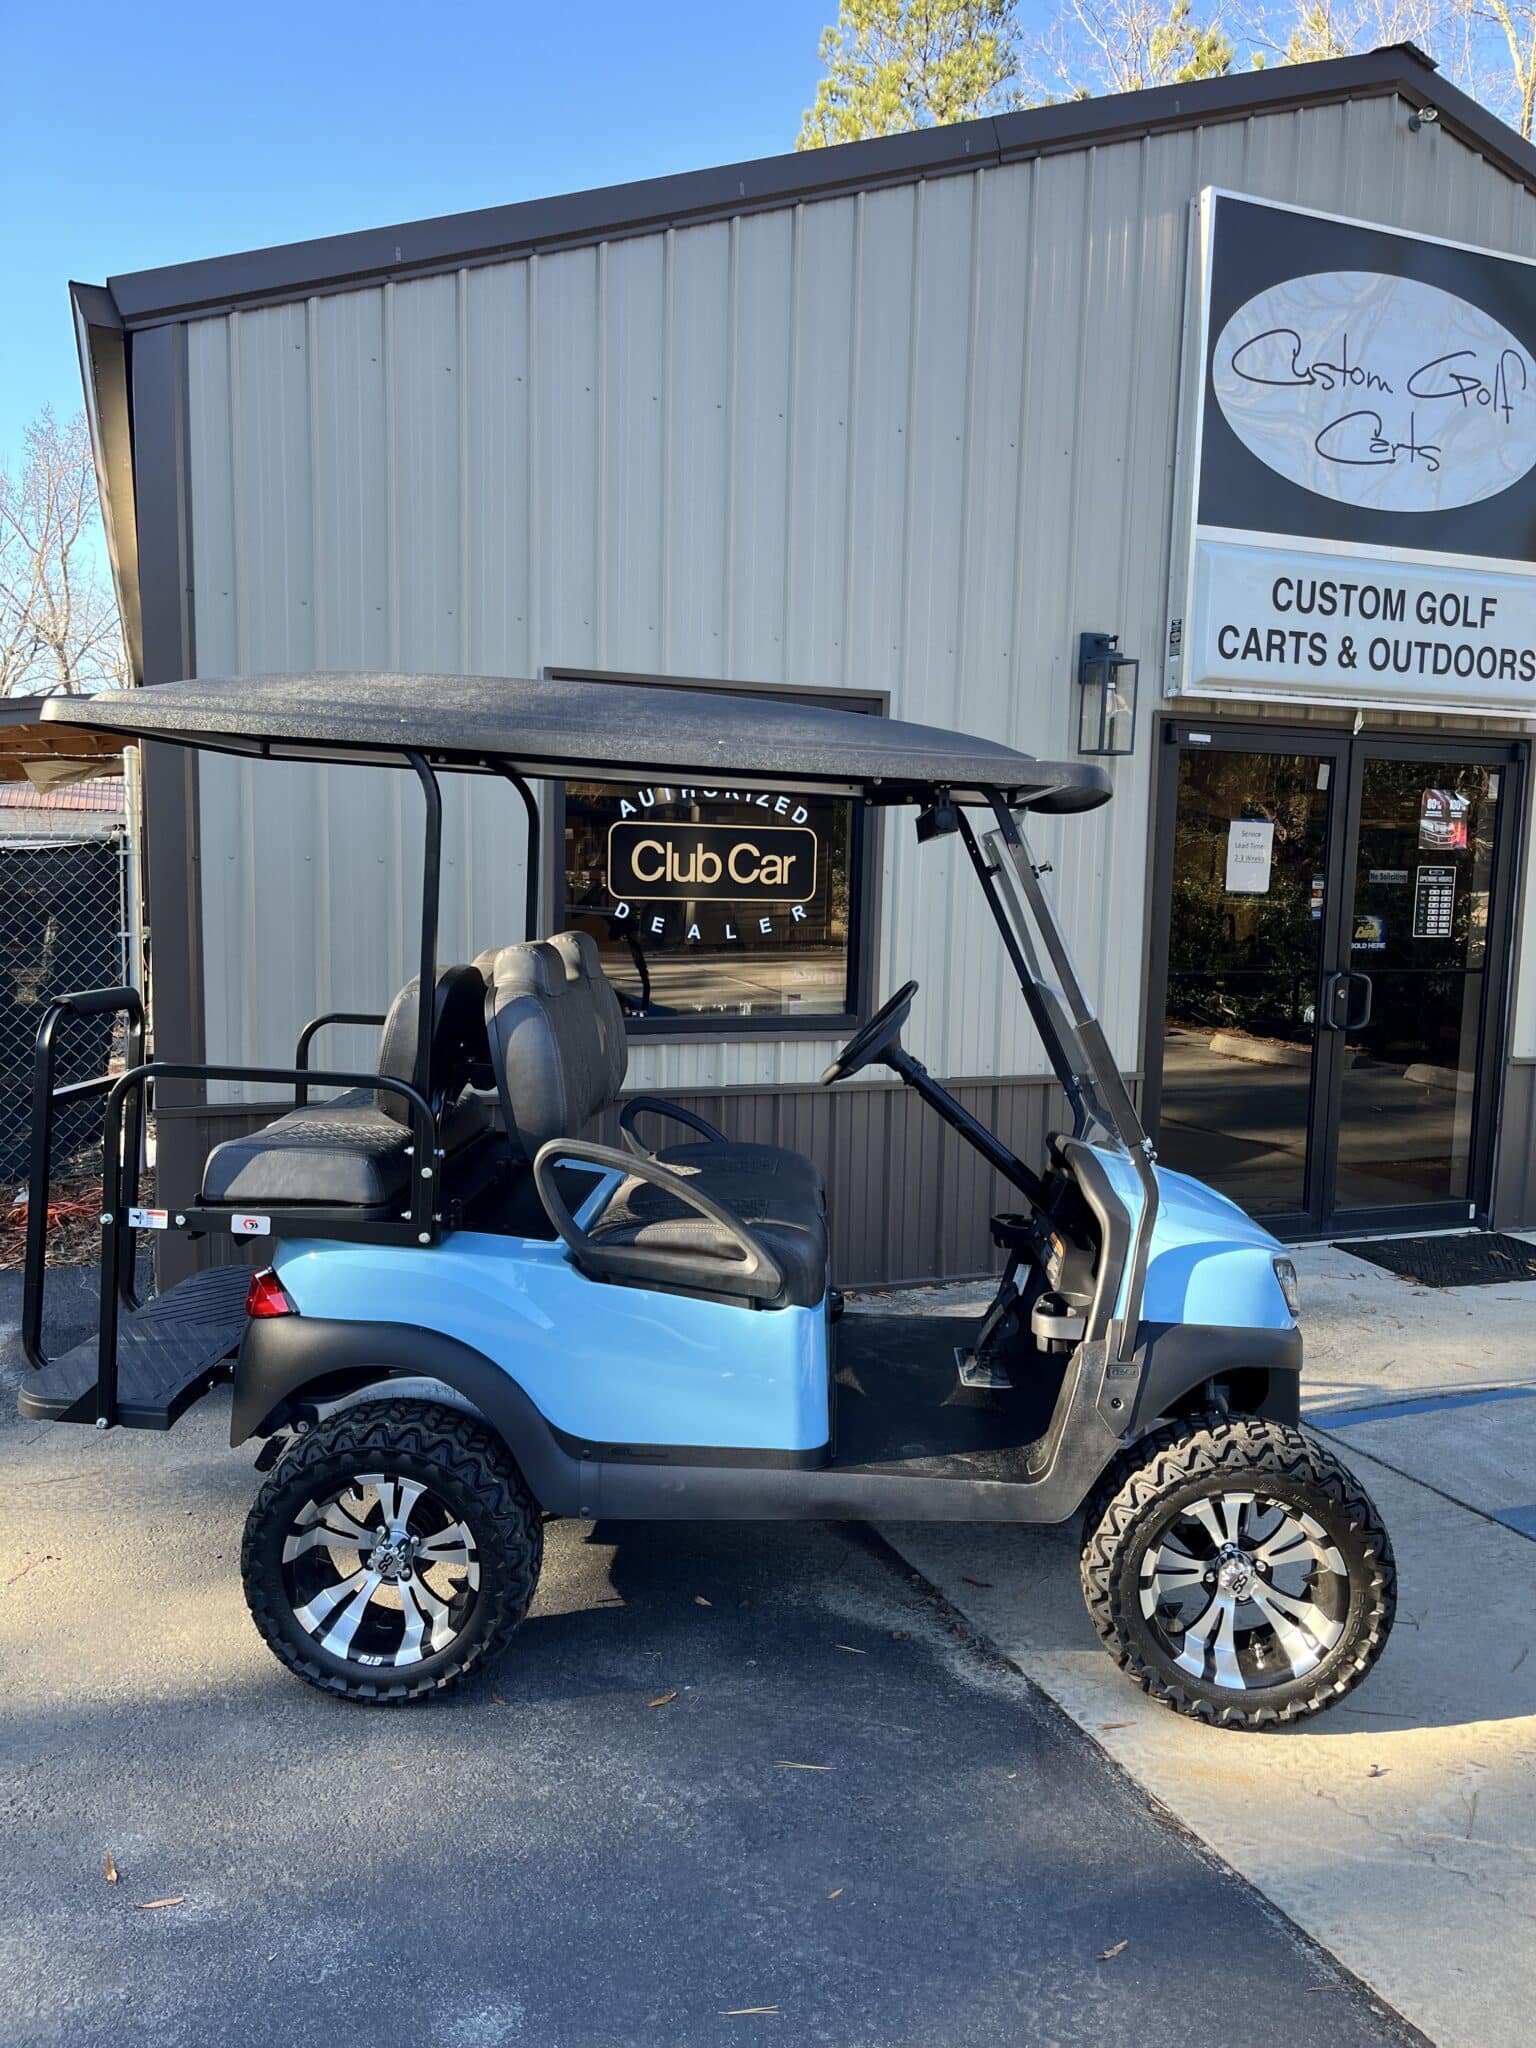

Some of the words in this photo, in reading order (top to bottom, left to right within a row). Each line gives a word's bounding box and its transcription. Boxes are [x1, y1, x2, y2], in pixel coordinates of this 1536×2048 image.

[1232, 329, 1393, 393] Custom
[1407, 349, 1526, 424] Golf
[1315, 411, 1441, 471] Carts
[1272, 577, 1406, 622] CUSTOM
[1416, 591, 1498, 629] GOLF
[1218, 625, 1327, 667] CARTS
[1338, 636, 1357, 669] &
[1369, 637, 1536, 682] OUTDOORS
[631, 840, 722, 884] Club
[728, 843, 796, 885] Car
[1370, 872, 1378, 881] No
[1380, 872, 1407, 883] Soliciting
[615, 902, 807, 940] DEALER
